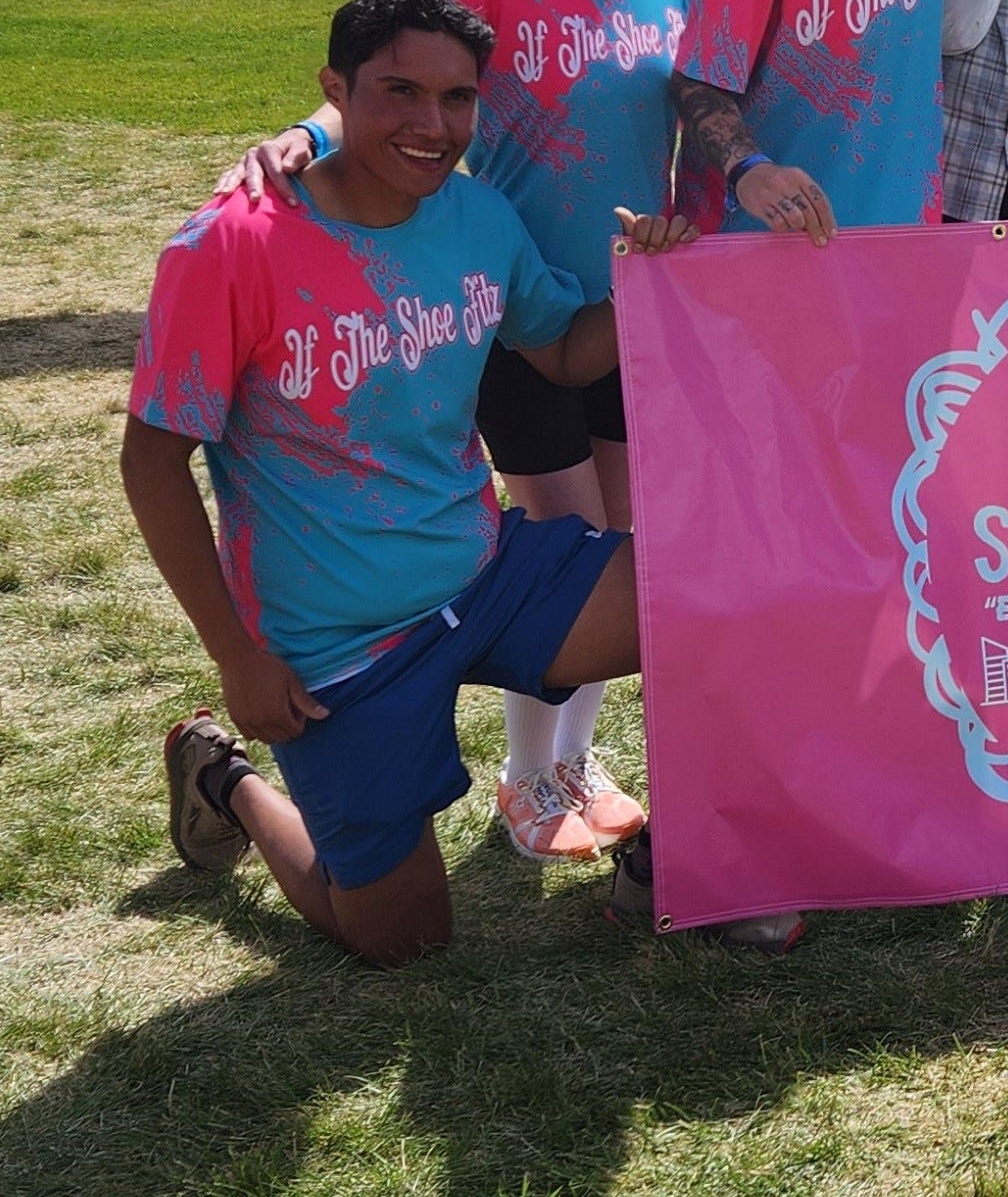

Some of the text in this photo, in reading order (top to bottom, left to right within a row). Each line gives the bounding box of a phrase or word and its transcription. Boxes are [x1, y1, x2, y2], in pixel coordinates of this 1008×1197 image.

[514, 20, 549, 83] If
[558, 14, 608, 78] The
[612, 9, 662, 71] Shoe
[278, 272, 503, 400] If The Shoe Fitz
